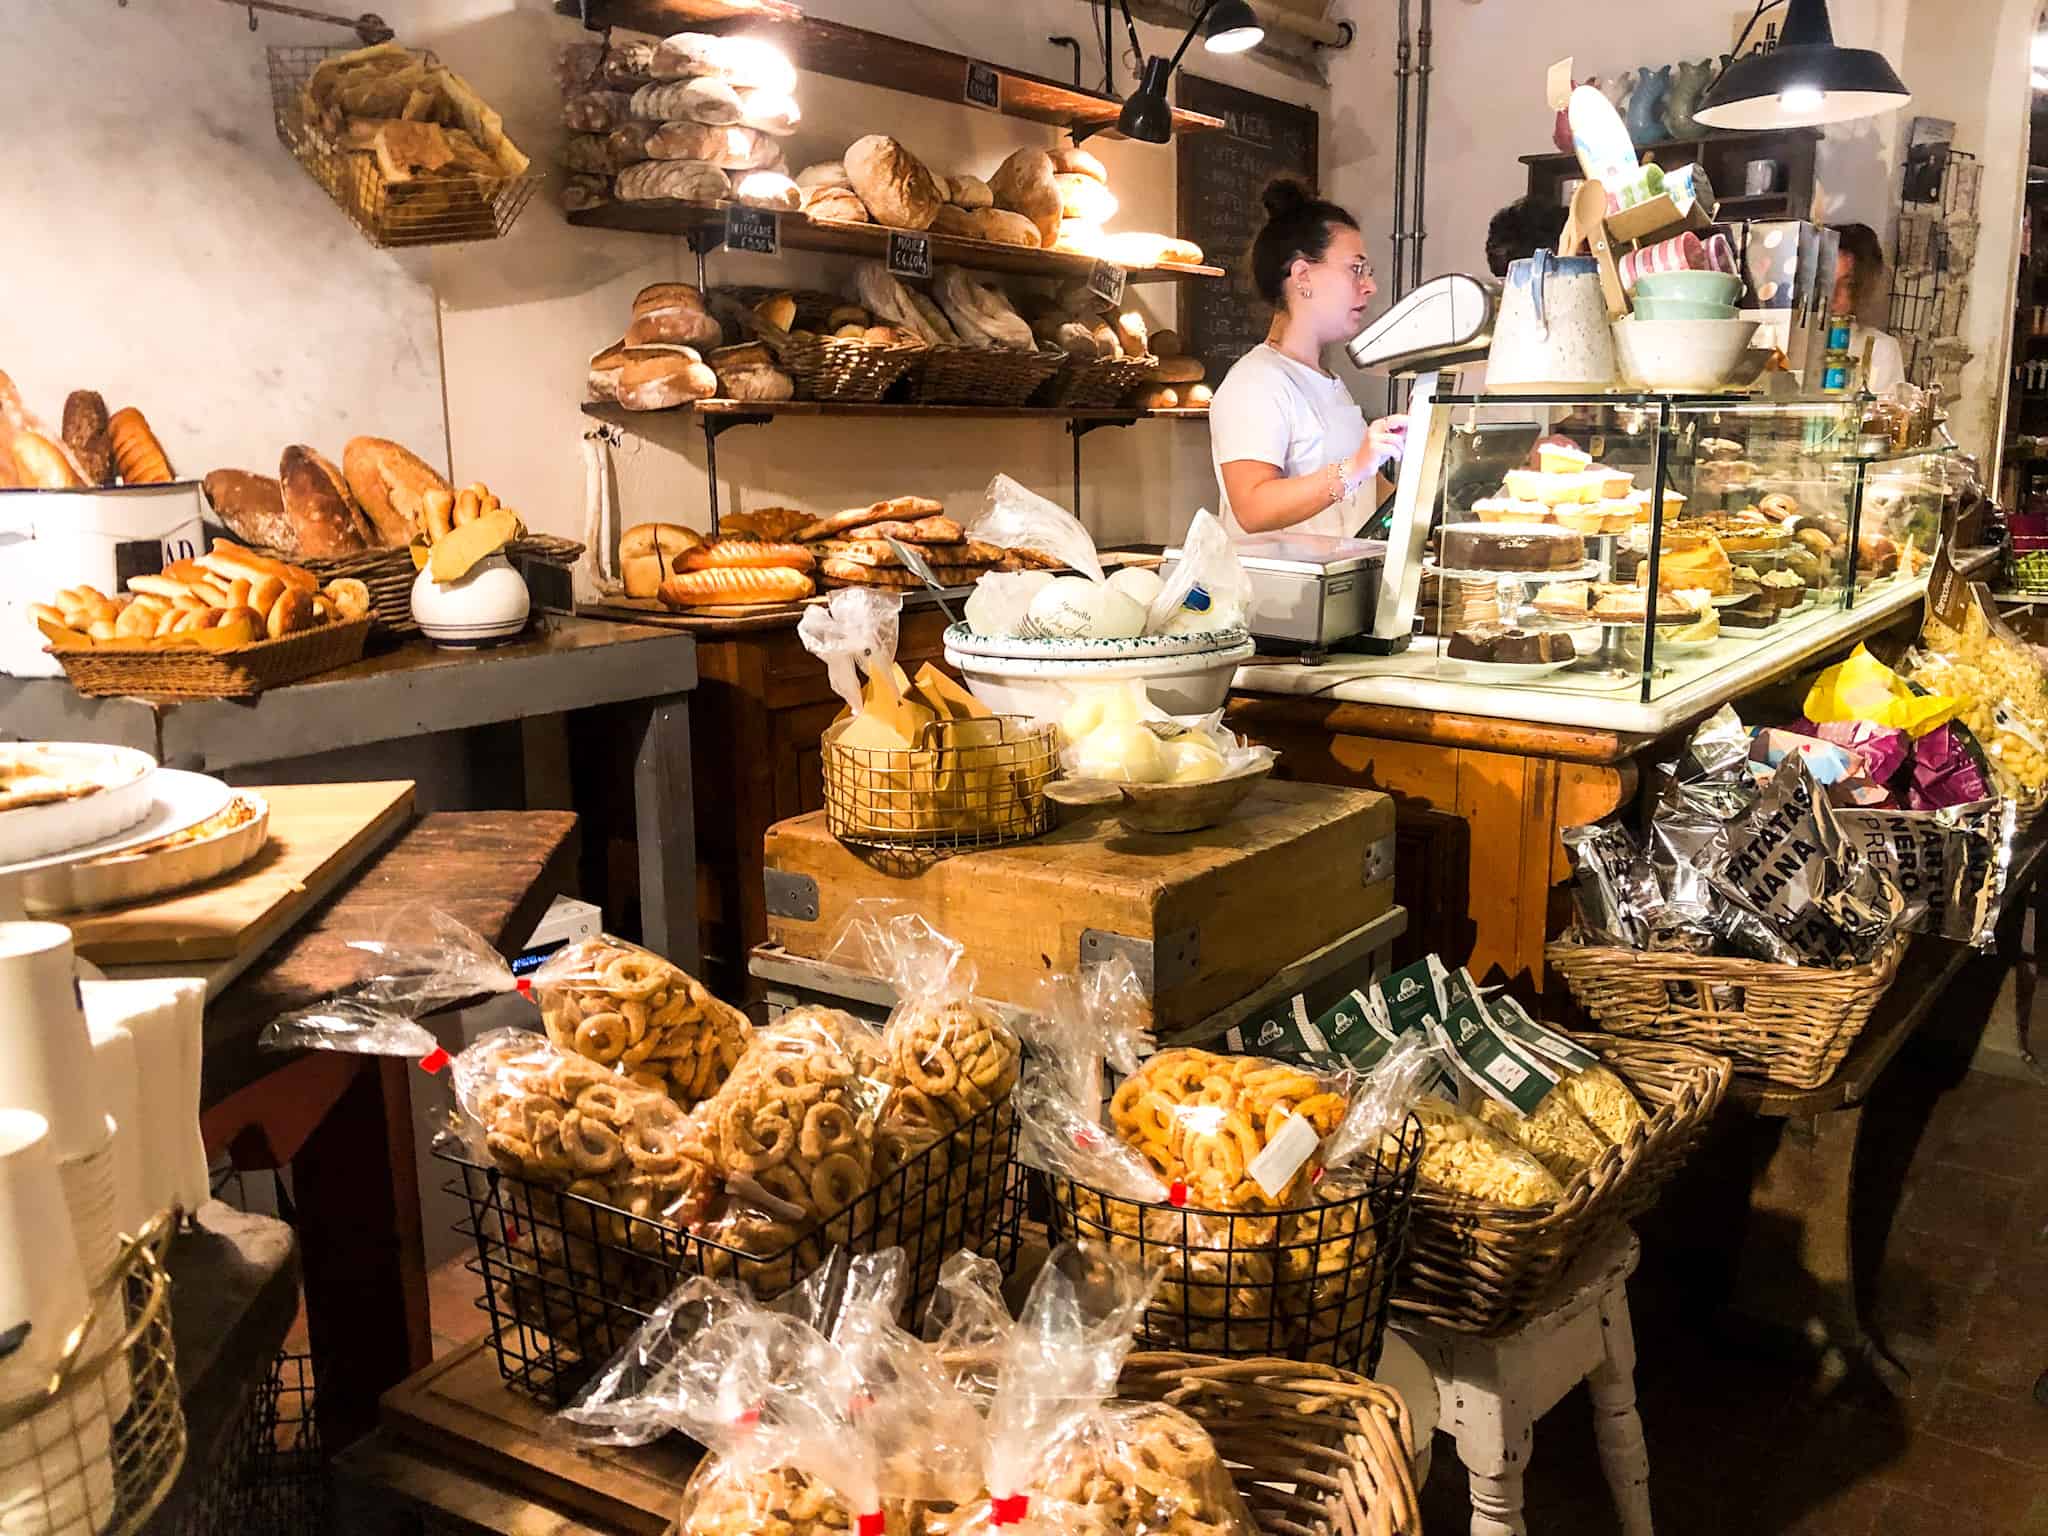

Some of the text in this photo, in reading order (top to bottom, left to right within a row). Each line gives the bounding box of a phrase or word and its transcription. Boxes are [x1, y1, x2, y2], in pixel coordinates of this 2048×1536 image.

[1764, 22, 1778, 40] IL
[1726, 786, 1813, 885] PATATAS
[1886, 817, 1921, 891] NERO
[1750, 839, 1817, 912] NANA
